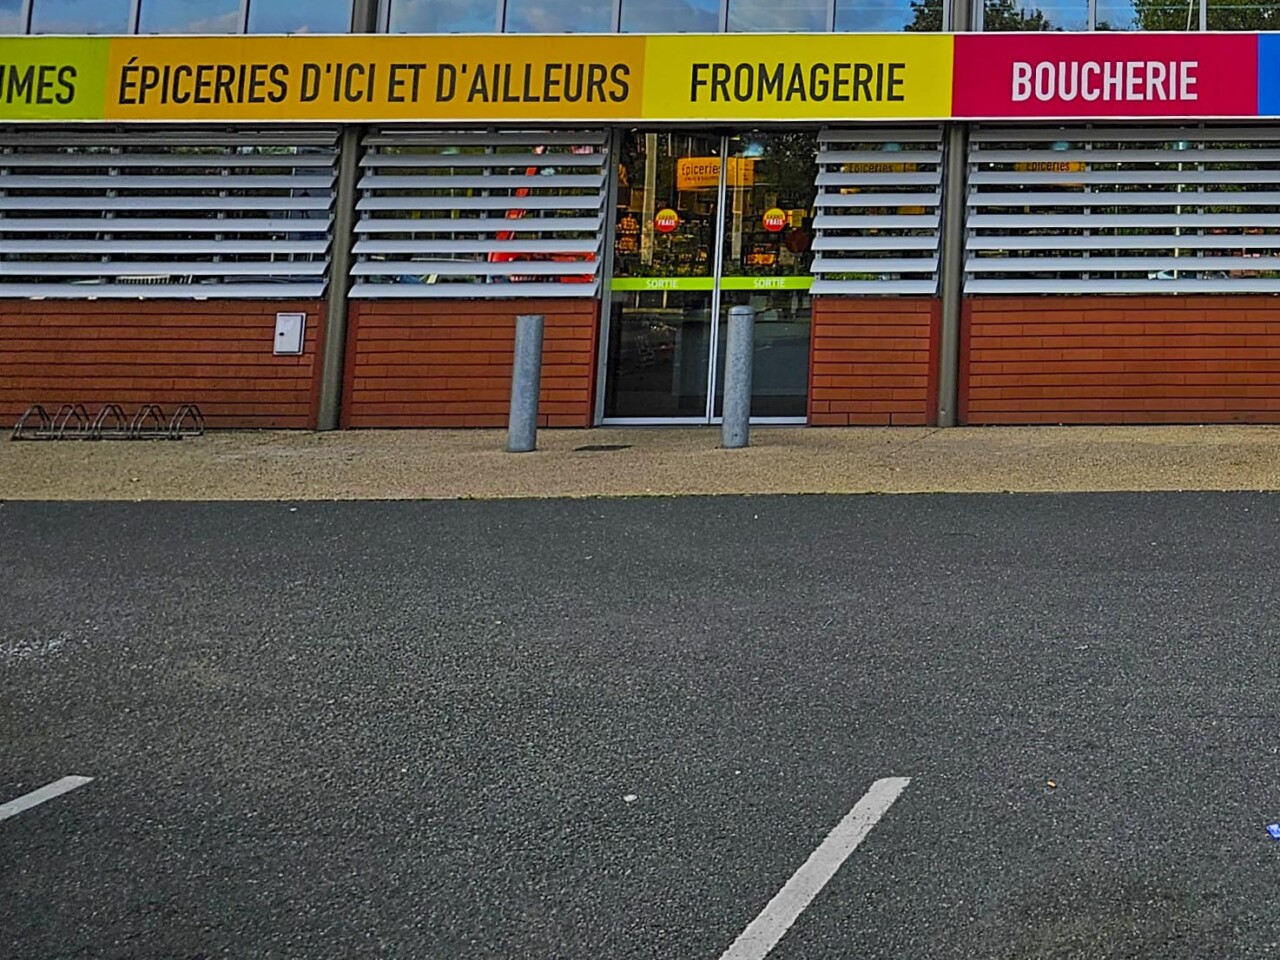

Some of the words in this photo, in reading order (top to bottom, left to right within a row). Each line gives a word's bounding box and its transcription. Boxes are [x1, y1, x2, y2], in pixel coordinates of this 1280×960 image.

[118, 57, 289, 105] ÉPICERIES
[299, 63, 376, 103] D'ICI
[387, 63, 427, 103] ET
[436, 62, 631, 103] D'AILLEURS
[689, 62, 906, 103] FROMAGERIE
[1011, 60, 1199, 102] BOUCHERIE
[682, 162, 722, 177] Epicerie
[646, 278, 678, 288] SORTIE
[753, 277, 785, 287] SORTIE
